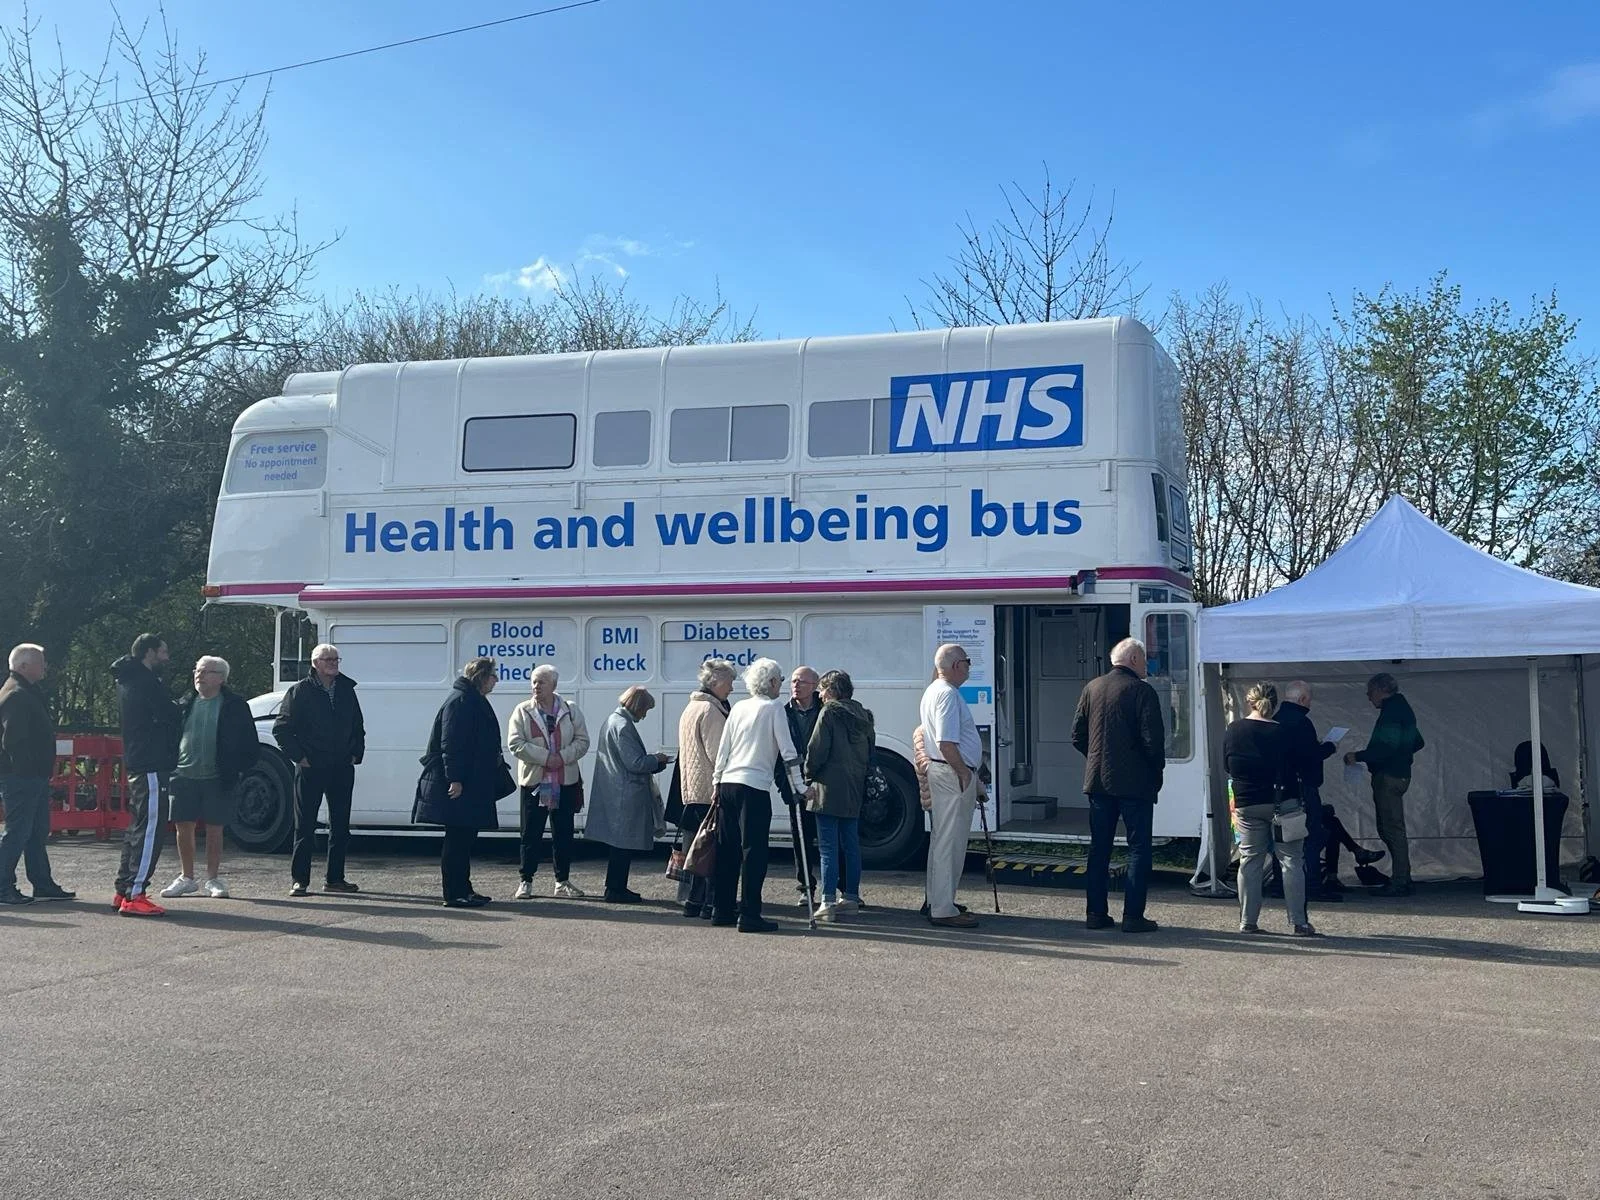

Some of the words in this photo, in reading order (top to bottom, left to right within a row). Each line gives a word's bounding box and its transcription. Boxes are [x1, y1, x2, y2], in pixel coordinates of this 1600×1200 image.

[896, 373, 1078, 448] NHS
[250, 444, 274, 455] Free
[277, 441, 317, 453] service
[245, 460, 257, 469] No
[259, 457, 317, 470] appointment
[264, 470, 298, 481] needed
[345, 505, 514, 554] Health
[533, 501, 635, 551] and
[655, 494, 950, 553] wellbeing
[970, 488, 1083, 538] bus
[491, 620, 544, 639] Blood
[602, 627, 639, 645] BMI
[683, 622, 770, 641] Diabetes
[477, 643, 556, 657] pressure
[593, 653, 647, 671] check
[496, 663, 536, 681] hec
